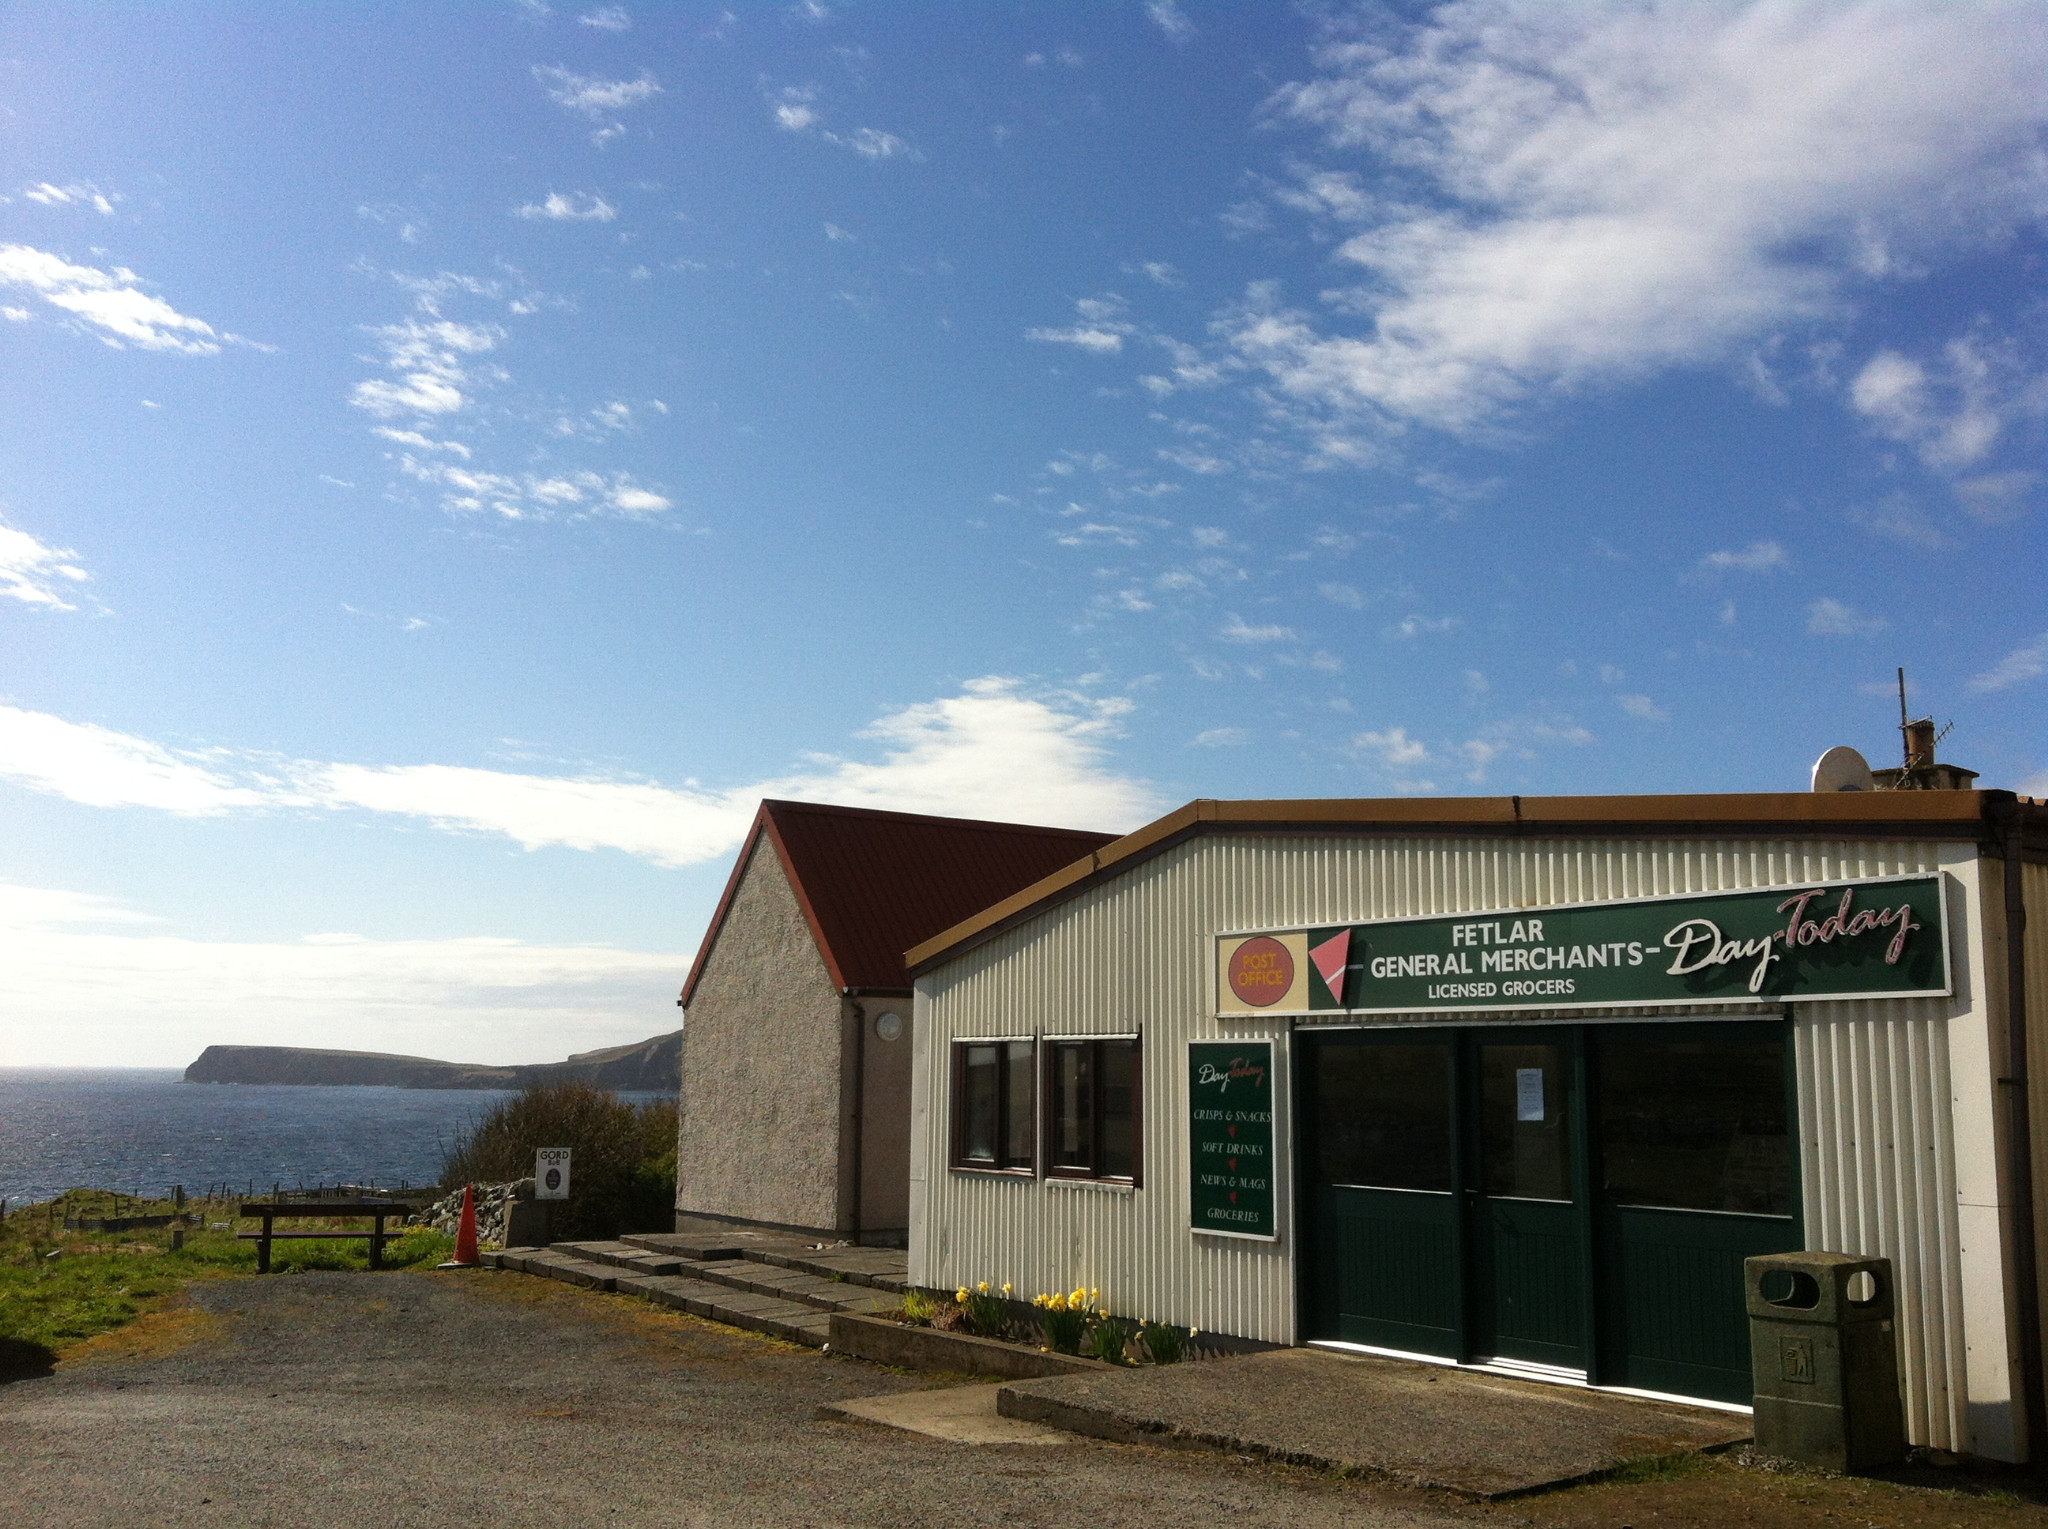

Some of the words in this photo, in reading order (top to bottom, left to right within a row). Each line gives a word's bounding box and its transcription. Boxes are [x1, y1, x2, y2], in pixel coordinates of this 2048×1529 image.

[1452, 919, 1545, 947] FETLAR
[1243, 953, 1277, 968] POST
[1371, 951, 1474, 979] GENERAL
[1238, 970, 1284, 987] OFFICE
[1428, 982, 1497, 999] LICENSED
[1502, 979, 1575, 997] GROCERS
[1193, 1109, 1223, 1121] CRISPS
[1225, 1110, 1232, 1121] &
[1235, 1110, 1272, 1123] SNACKS
[540, 1150, 569, 1160] GORD
[1202, 1141, 1224, 1154] SOFT
[1226, 1142, 1264, 1156] DRINKS
[1200, 1174, 1227, 1187] NEWS
[1229, 1176, 1237, 1187] &
[1239, 1176, 1266, 1190] MAGS
[1207, 1207, 1260, 1223] GROCERIES
